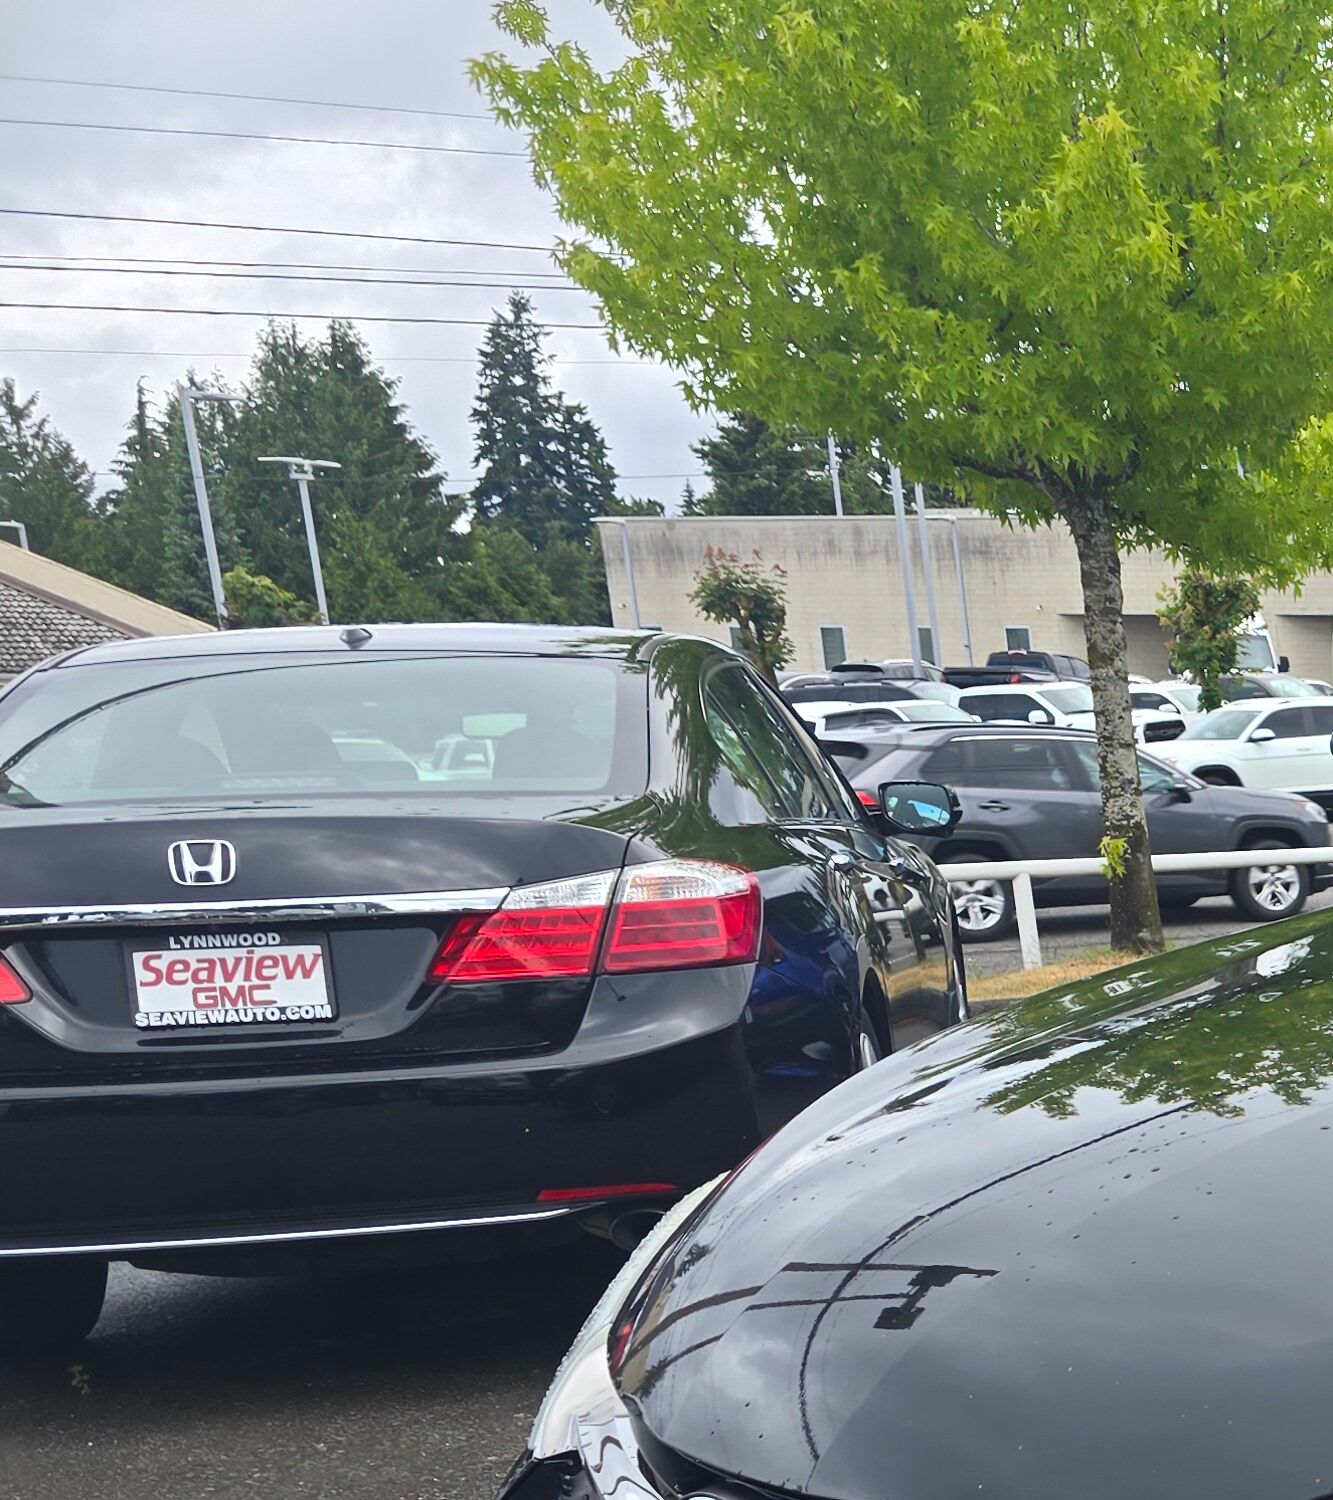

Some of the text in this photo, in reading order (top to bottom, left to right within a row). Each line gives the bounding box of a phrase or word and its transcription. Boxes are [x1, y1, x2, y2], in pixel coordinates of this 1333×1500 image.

[168, 932, 281, 950] LYNNWOOD
[139, 949, 323, 988] Seaview
[191, 983, 278, 1010] GMC
[134, 1004, 333, 1028] SEAVIEWAUTO.COM
